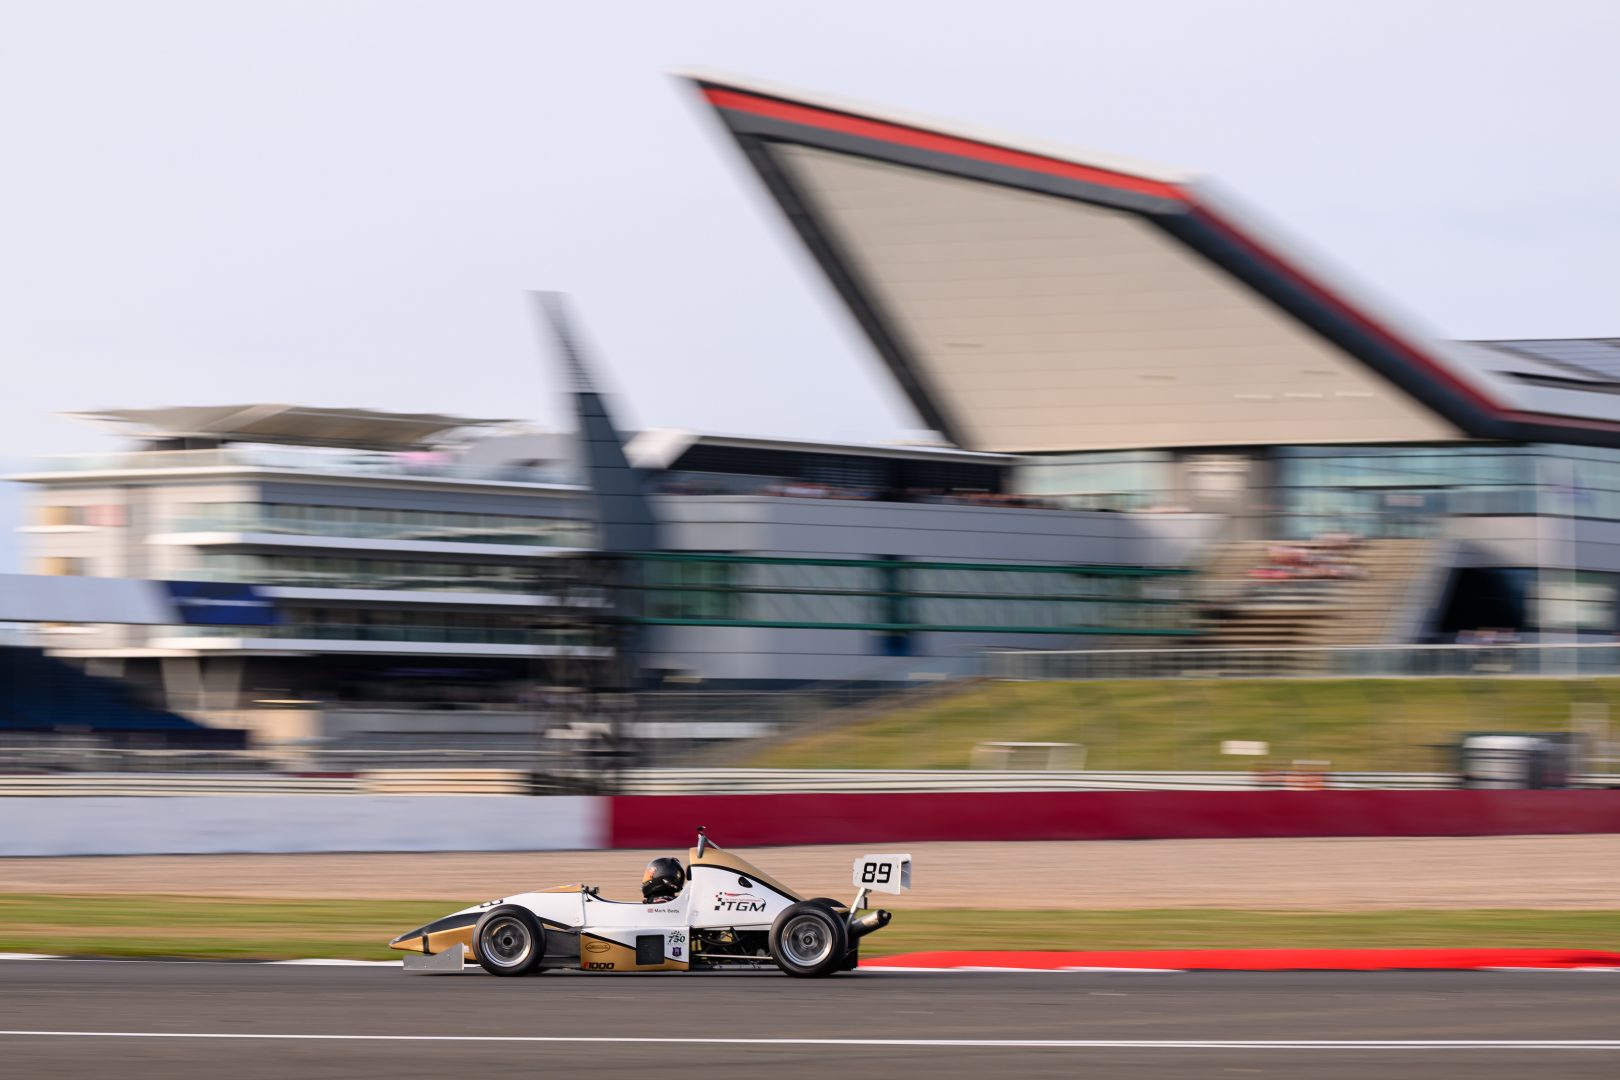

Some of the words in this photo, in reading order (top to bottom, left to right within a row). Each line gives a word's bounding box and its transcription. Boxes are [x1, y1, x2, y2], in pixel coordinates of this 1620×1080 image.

[861, 862, 892, 883] 89
[726, 901, 766, 912] TGM
[668, 935, 685, 943] 750
